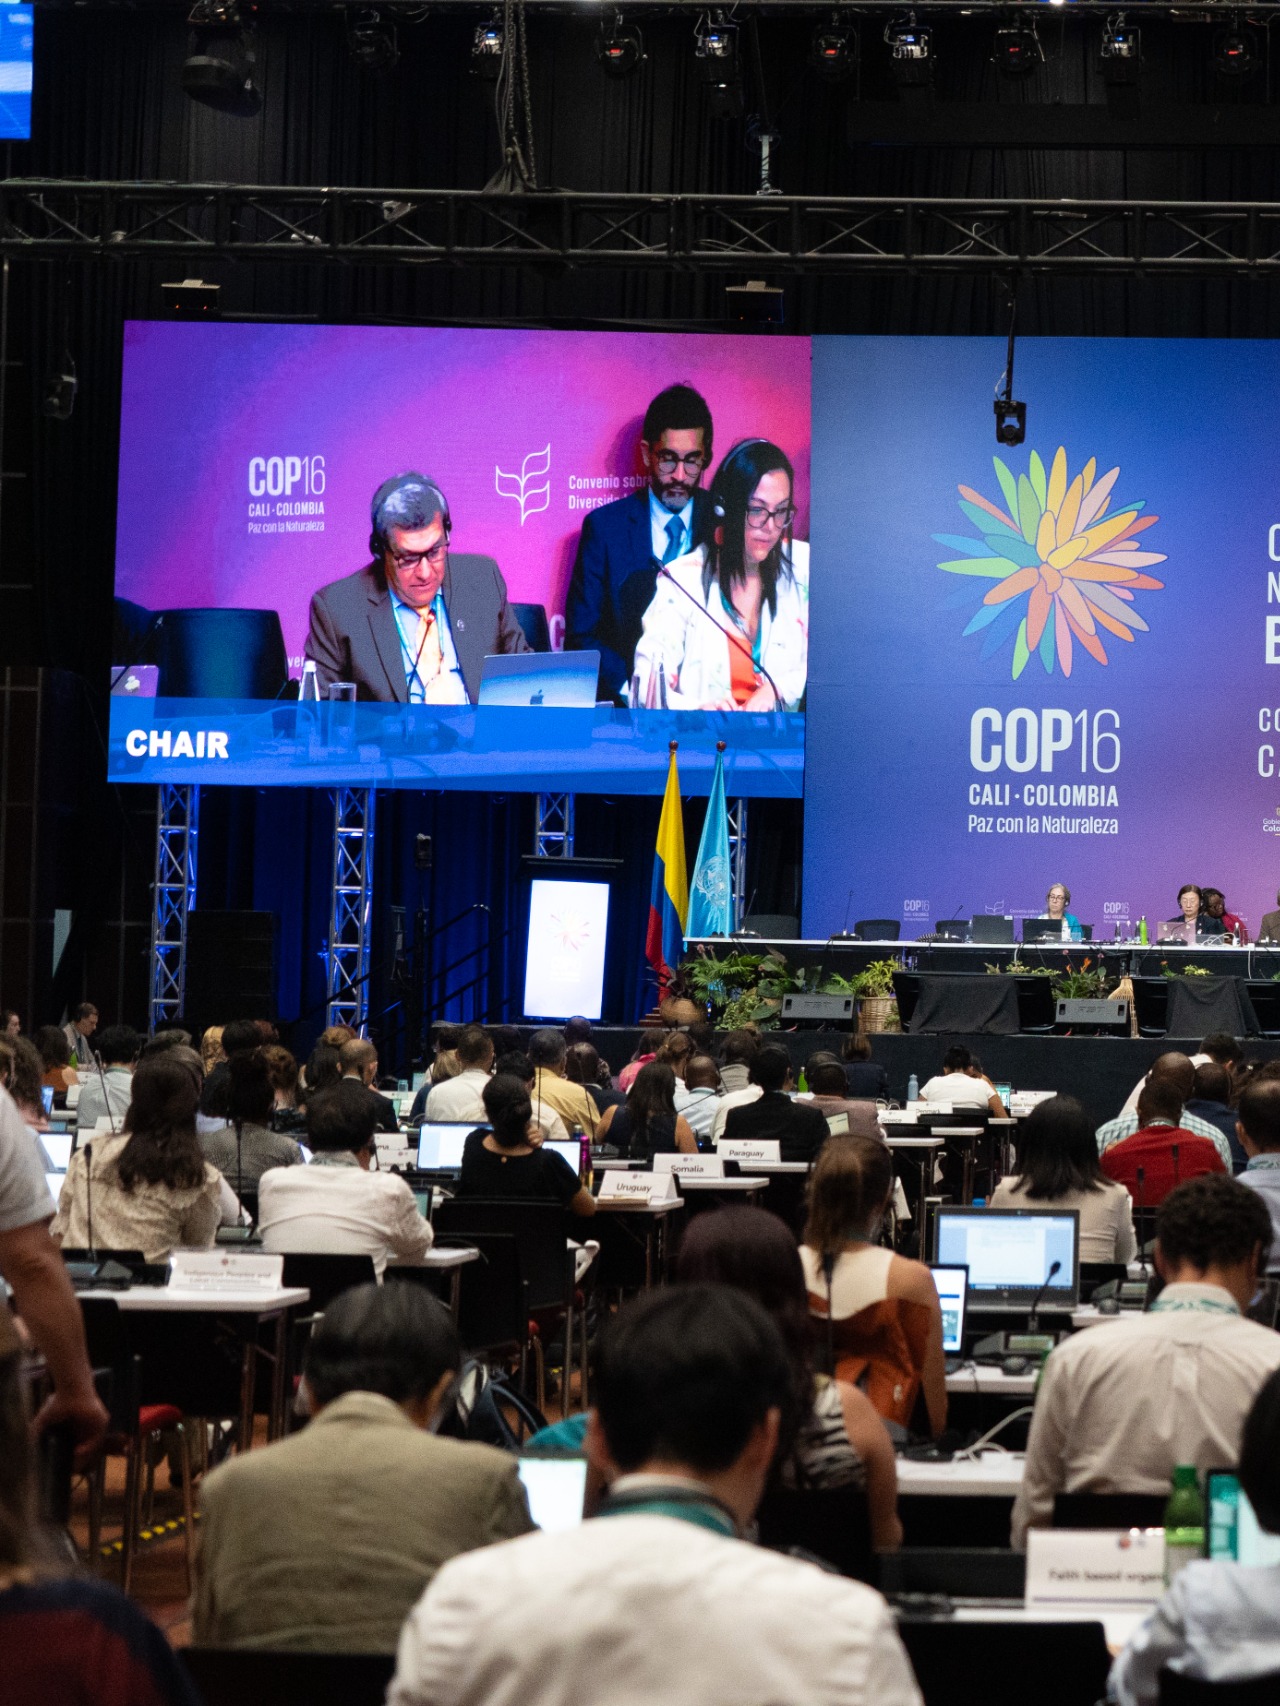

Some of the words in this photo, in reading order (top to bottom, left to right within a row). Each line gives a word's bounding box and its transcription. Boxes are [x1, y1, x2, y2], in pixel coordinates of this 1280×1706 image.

[248, 455, 326, 496] COP16
[568, 474, 620, 489] Convenio
[248, 503, 270, 517] CALI
[276, 501, 325, 516] COLOMBIA
[568, 494, 627, 509] Diversid
[248, 522, 261, 534] Paz
[262, 522, 277, 533] con
[278, 521, 285, 533] la
[286, 520, 325, 532] Naturaleza
[126, 729, 229, 758] CHAIR
[969, 707, 1121, 773] COP16
[969, 783, 1010, 806] CALI
[1023, 784, 1119, 807] COLOMBIA
[968, 814, 993, 833] Paz
[996, 817, 1023, 833] con
[1026, 815, 1039, 833] la
[1042, 815, 1119, 834] Naturaleza
[903, 899, 930, 911] COP16
[728, 1149, 764, 1159] Paraguay
[670, 1164, 704, 1174] Somalia
[616, 1182, 652, 1193] Uruguay
